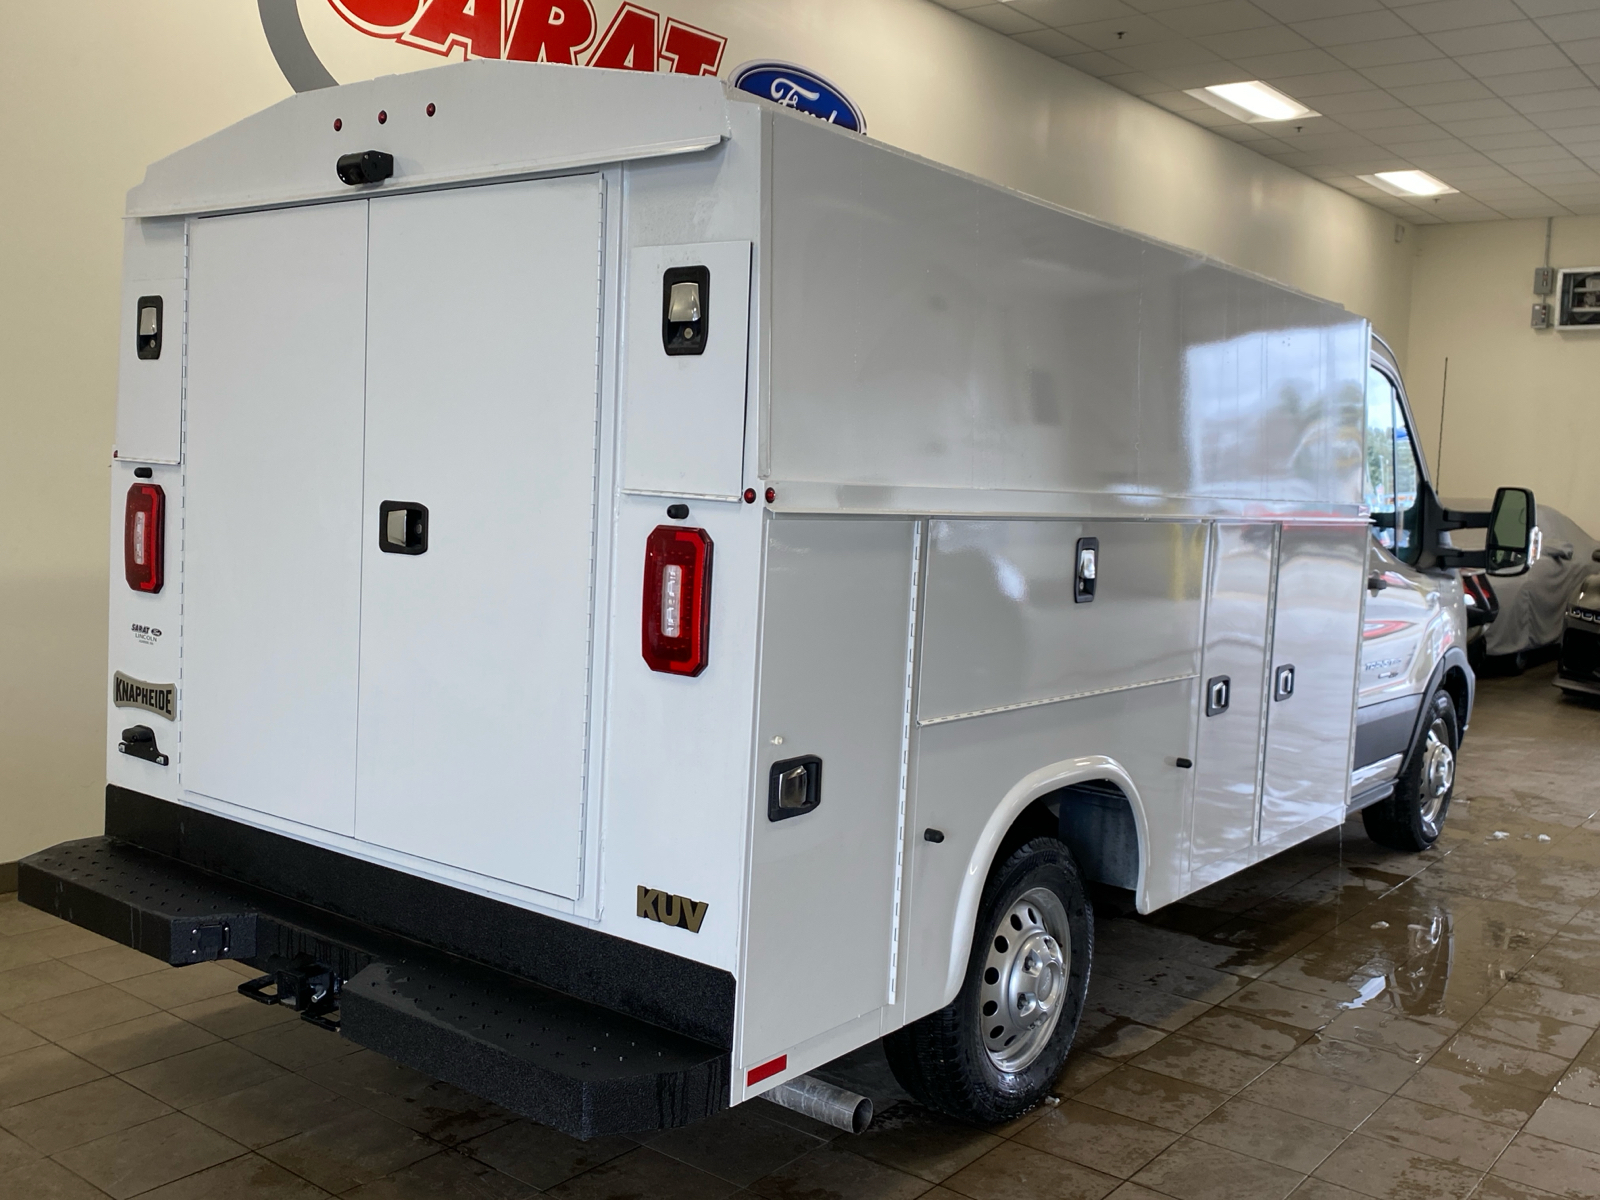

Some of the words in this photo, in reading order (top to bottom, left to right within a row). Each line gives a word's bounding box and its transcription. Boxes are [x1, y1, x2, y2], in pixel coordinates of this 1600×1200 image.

[131, 623, 150, 634] SARAT
[135, 633, 157, 642] LINCOLN
[115, 677, 173, 715] KNAPHEIDE
[637, 885, 709, 934] KUV
